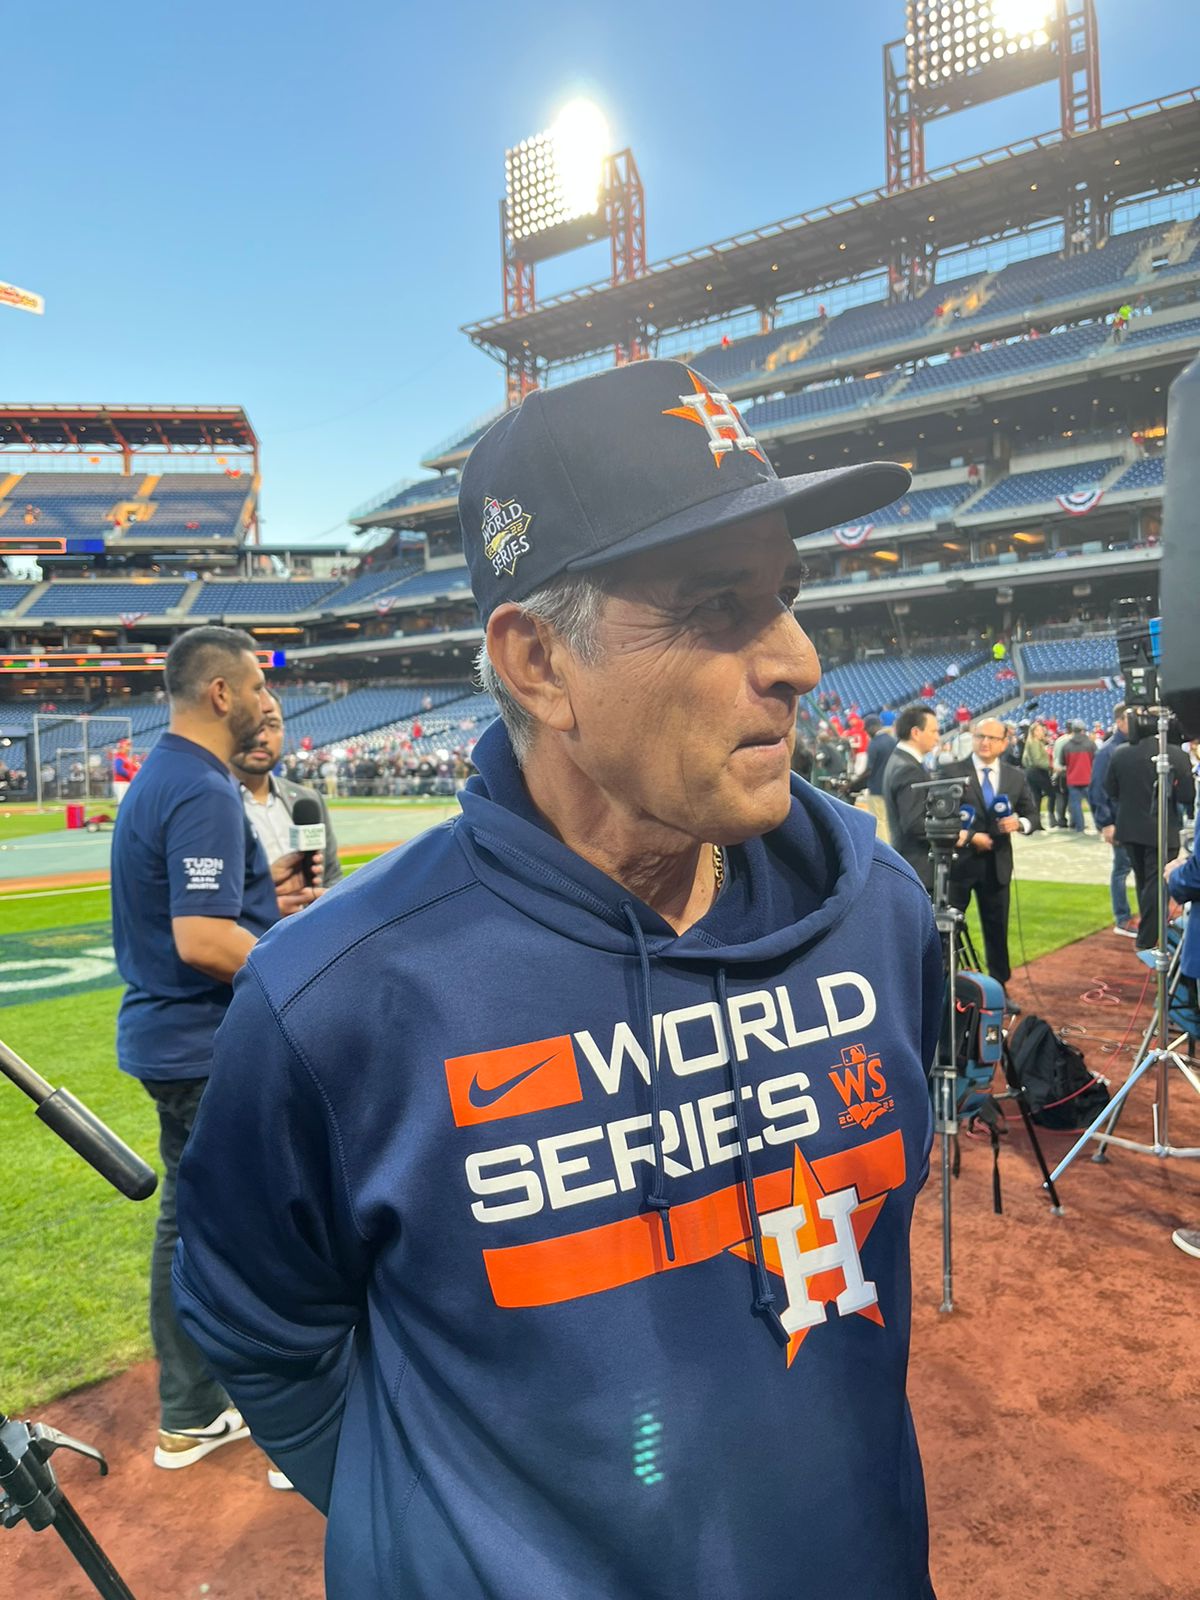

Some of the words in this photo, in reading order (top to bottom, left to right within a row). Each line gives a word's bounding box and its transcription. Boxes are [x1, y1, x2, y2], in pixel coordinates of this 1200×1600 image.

[482, 503, 522, 545] WORLD
[492, 535, 530, 576] SERIES
[182, 857, 224, 870] TUDN
[573, 971, 877, 1095] WORLD
[828, 1058, 887, 1107] WS
[838, 1114, 853, 1125] 20
[465, 1072, 821, 1223] SERIES
[758, 1187, 878, 1334] H
